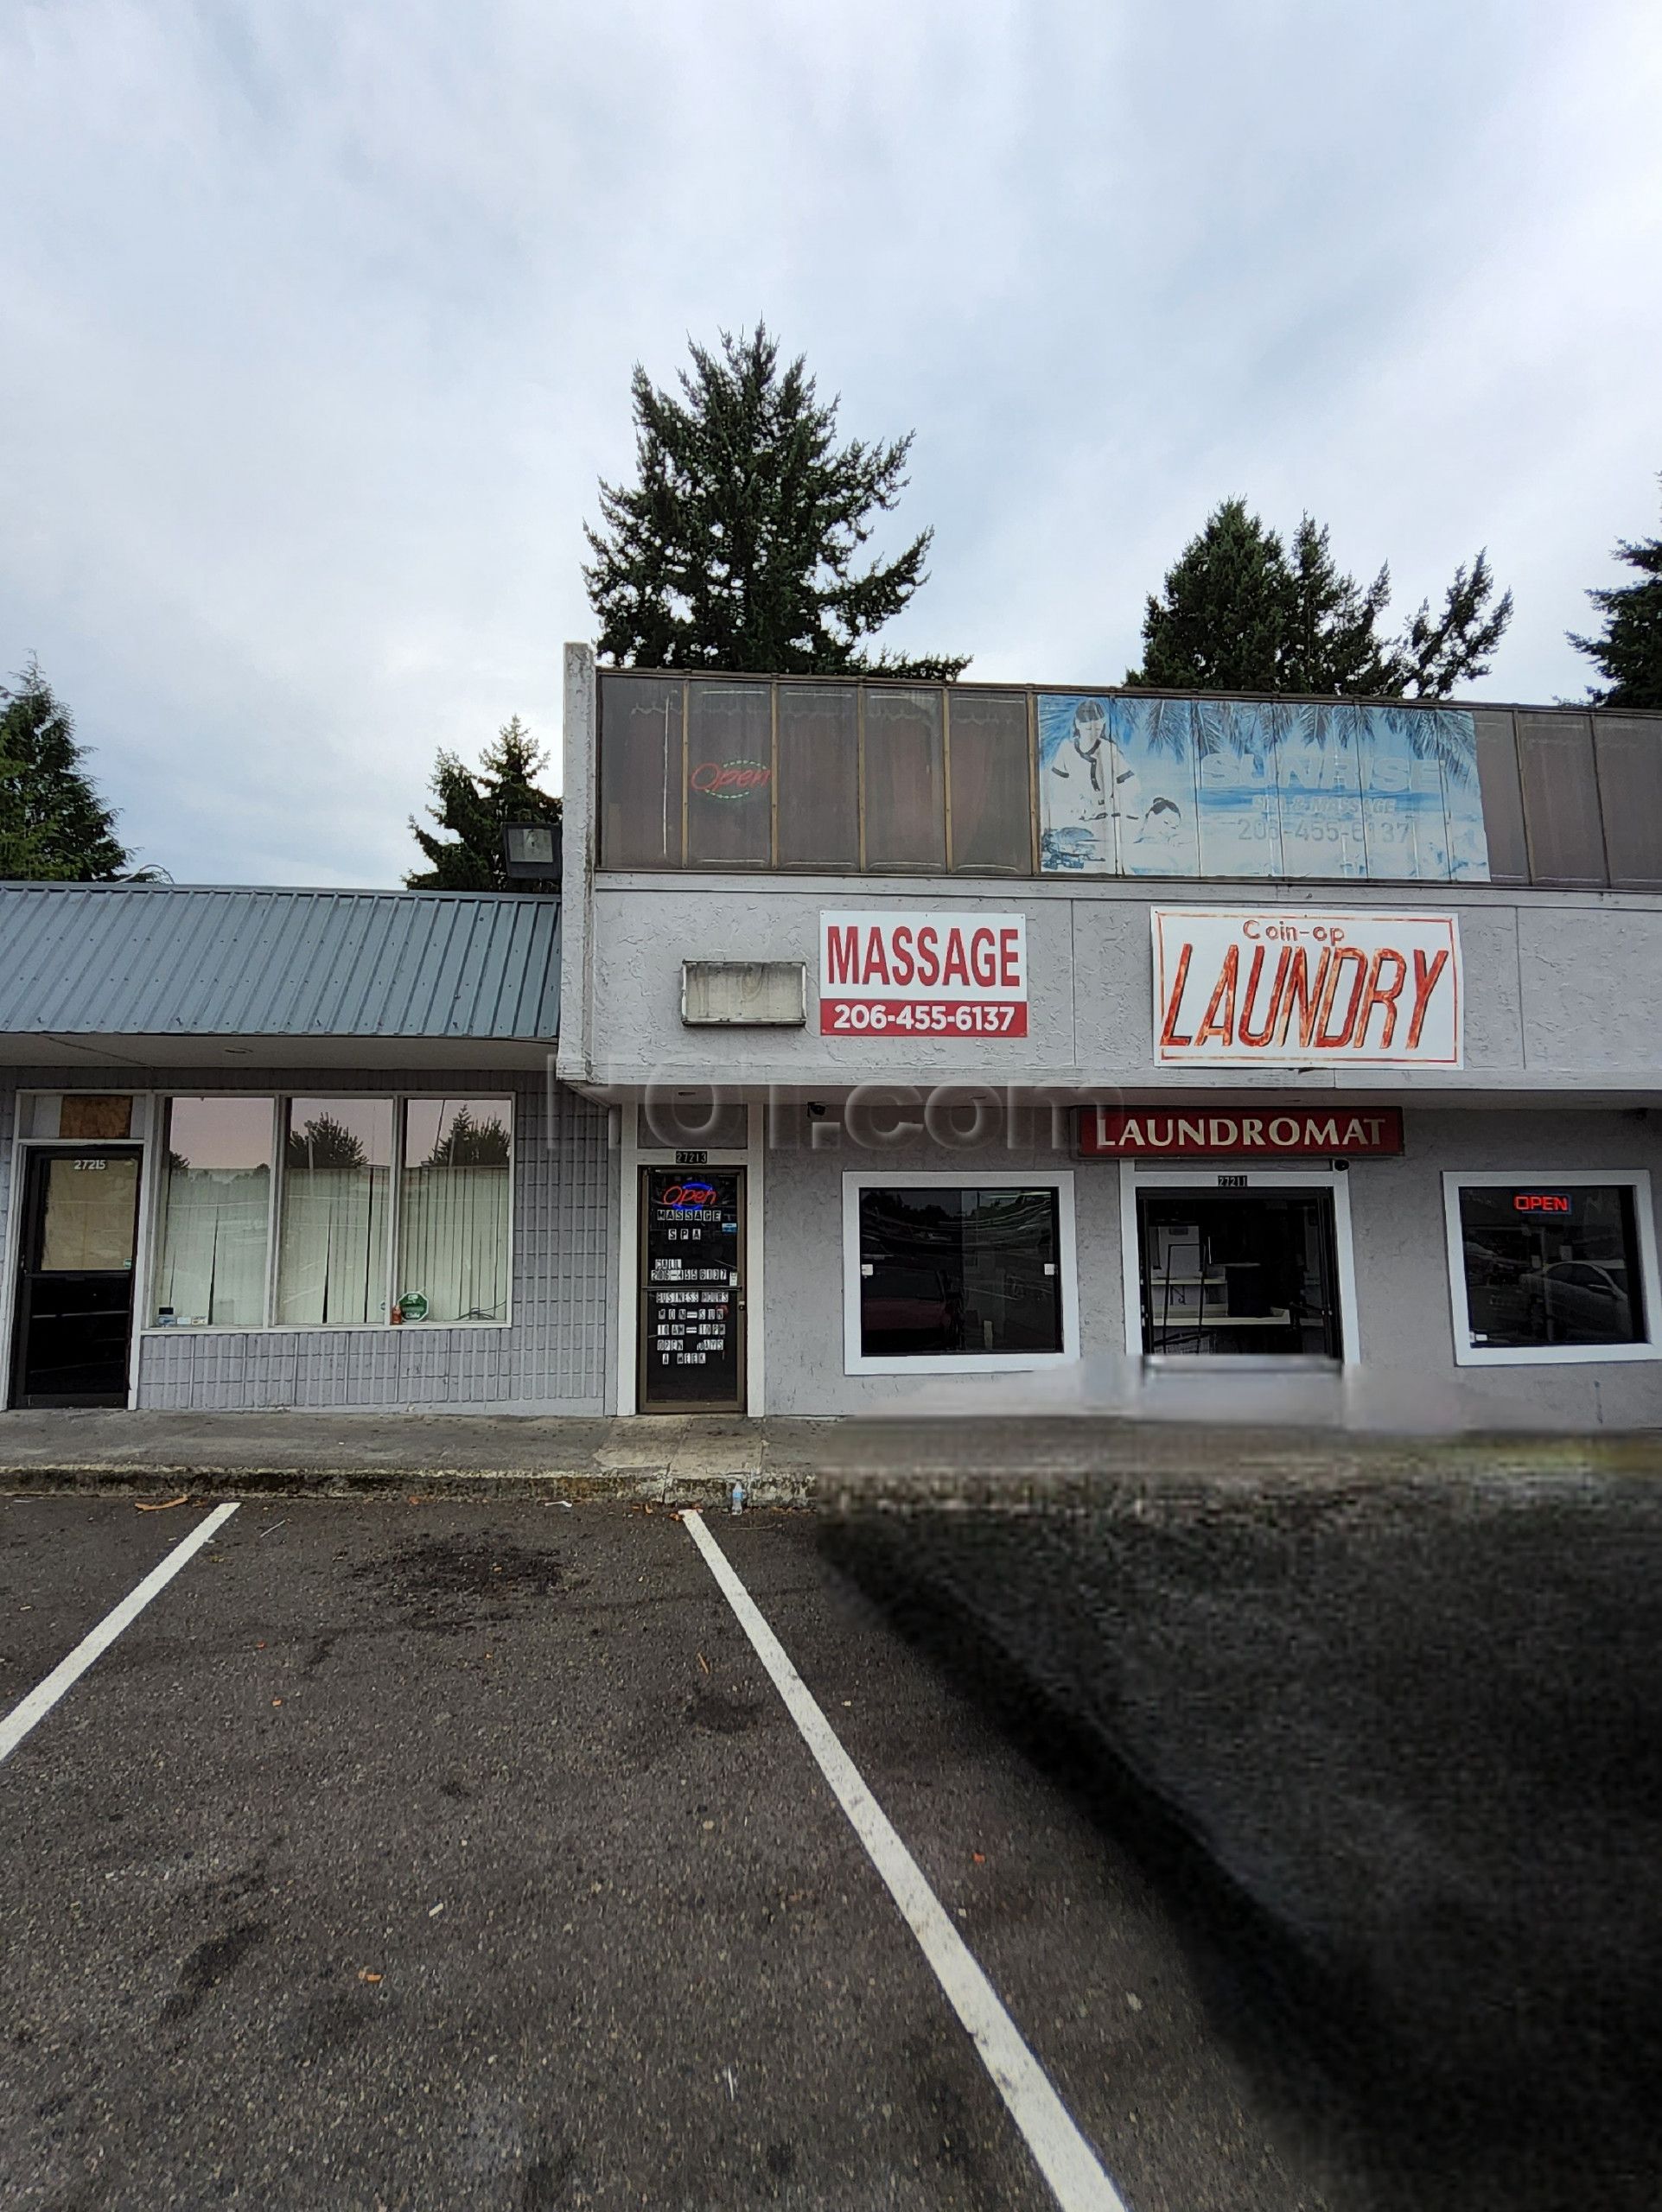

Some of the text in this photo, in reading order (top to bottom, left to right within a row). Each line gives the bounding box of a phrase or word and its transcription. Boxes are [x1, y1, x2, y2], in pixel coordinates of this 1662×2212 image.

[691, 762, 771, 792] Open
[1238, 817, 1410, 843] 206-455-6137
[1243, 919, 1345, 946] Coin-op
[827, 925, 1021, 987] MASSAGE
[1160, 944, 1449, 1050] LAUNDRY
[834, 1004, 1015, 1032] 206-455-6137
[1097, 1117, 1385, 1147] LAUNDROMAT
[74, 1160, 105, 1170] 27215
[677, 1153, 706, 1162] 27213
[1219, 1177, 1245, 1186] 27211
[663, 1185, 716, 1205] Open
[1515, 1196, 1568, 1211] OPEN
[657, 1210, 721, 1221] MASSAGE
[669, 1229, 701, 1240] SPA
